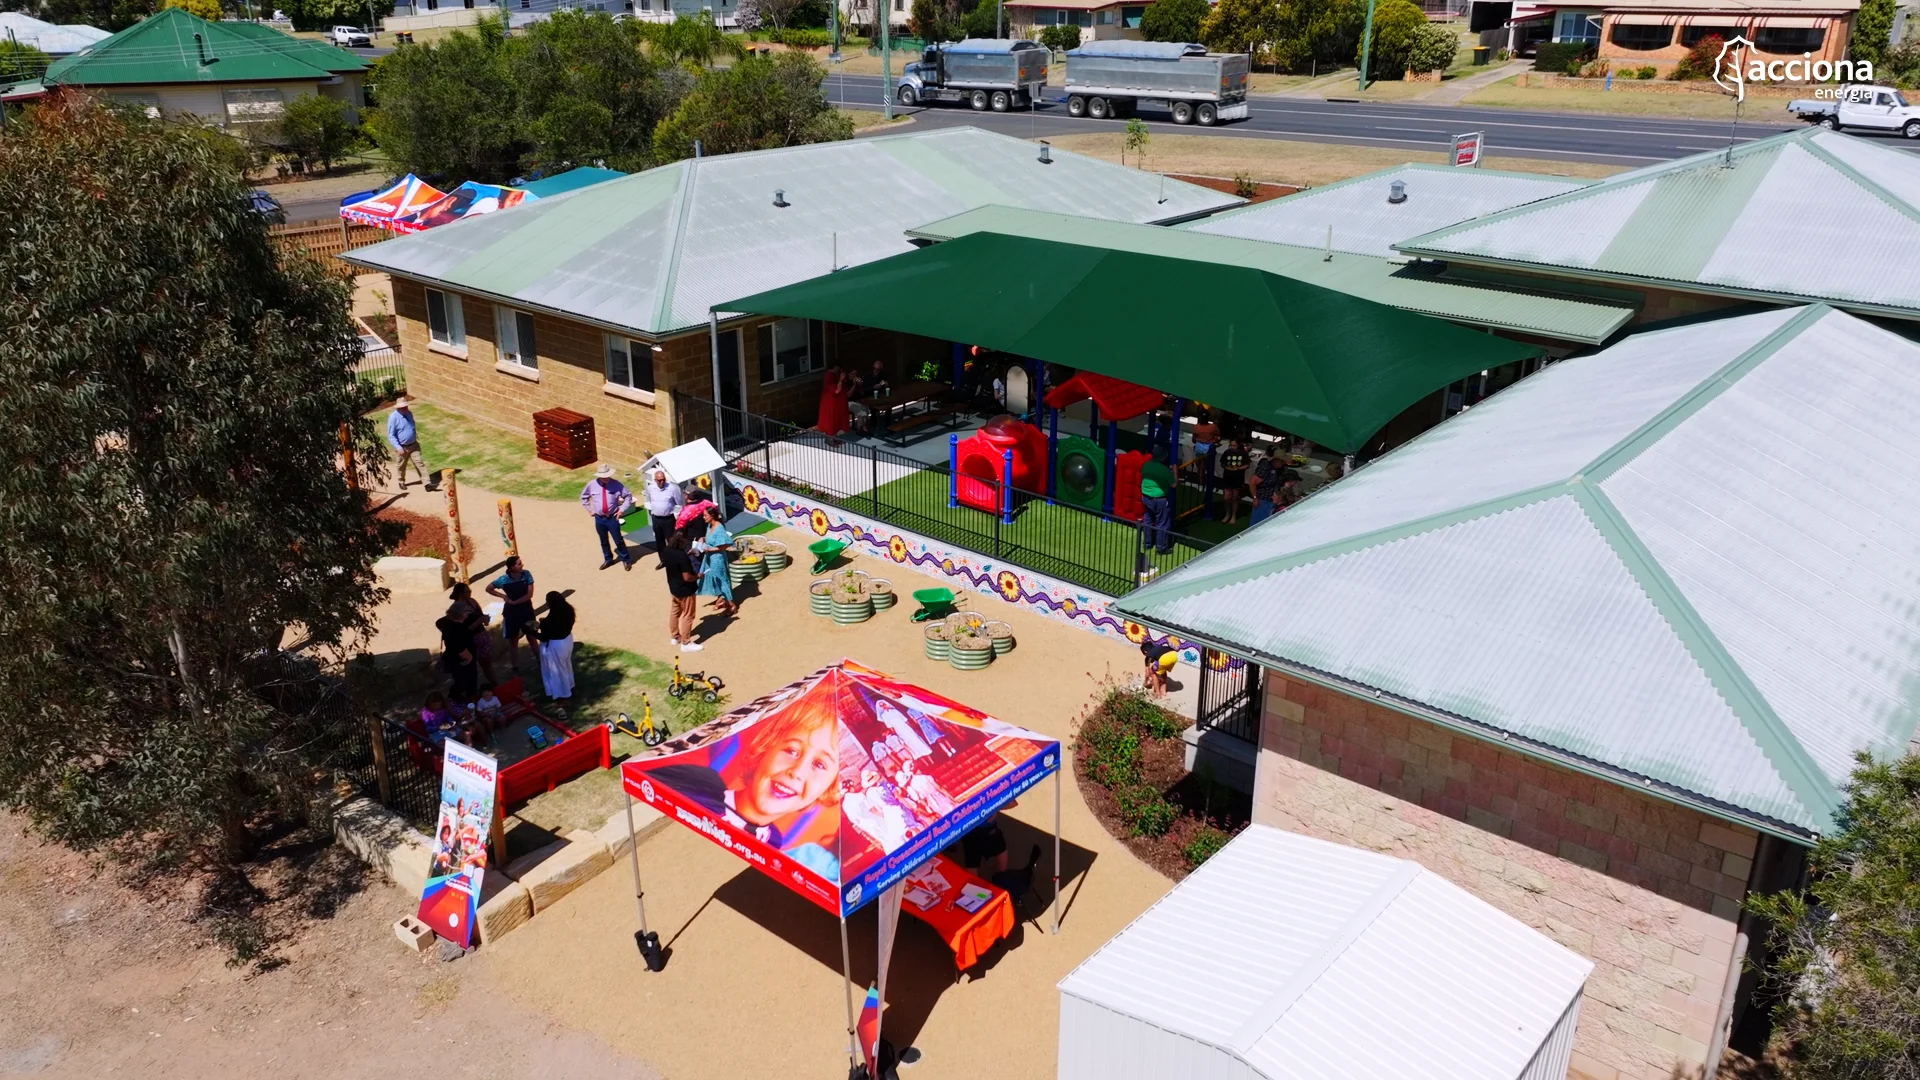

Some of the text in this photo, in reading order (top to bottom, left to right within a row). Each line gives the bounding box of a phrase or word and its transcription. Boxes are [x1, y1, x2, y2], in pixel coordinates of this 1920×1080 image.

[864, 762, 1036, 885] Royal Queensland Bush Children's Health Scheme
[877, 870, 901, 891] Serving
[901, 852, 926, 875] children
[926, 842, 938, 856] and
[939, 828, 961, 848] families
[962, 815, 980, 831] across
[980, 791, 1013, 818] Queensland
[1013, 785, 1022, 797] for
[1029, 770, 1043, 786] years
